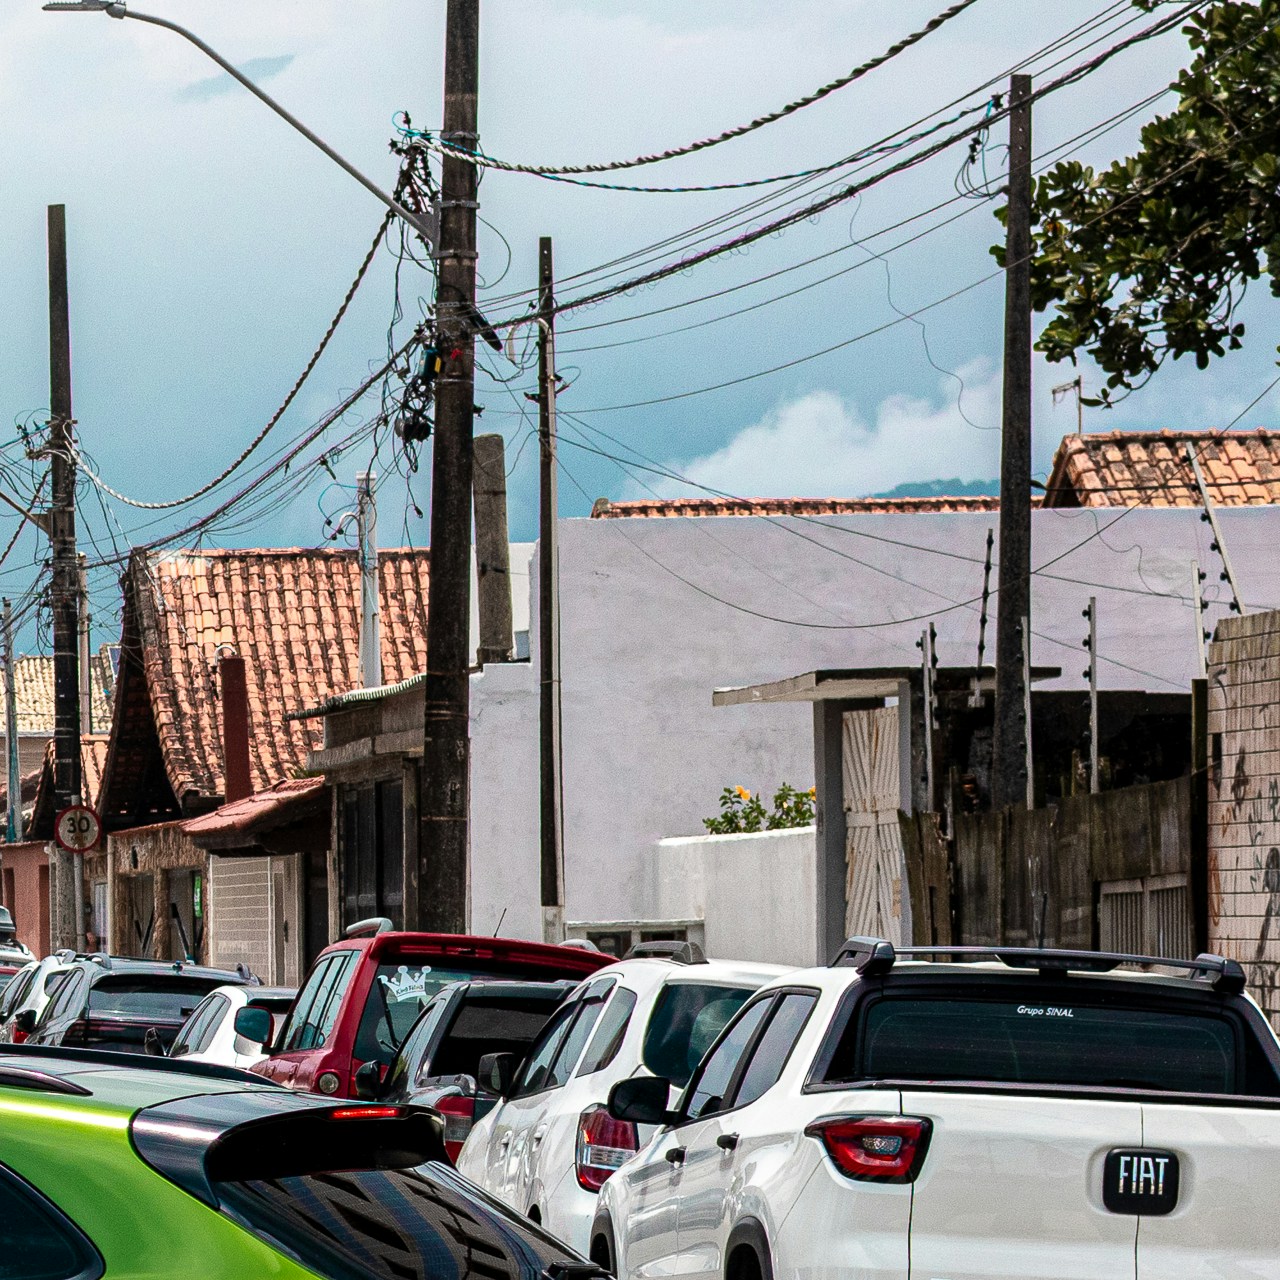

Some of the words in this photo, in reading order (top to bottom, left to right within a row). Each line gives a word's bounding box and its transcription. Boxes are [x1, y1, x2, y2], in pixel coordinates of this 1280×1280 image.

[67, 817, 90, 833] 30
[1017, 1005, 1044, 1016] Grupo
[1046, 1007, 1074, 1017] SINAL
[1119, 1156, 1169, 1195] FIAT
